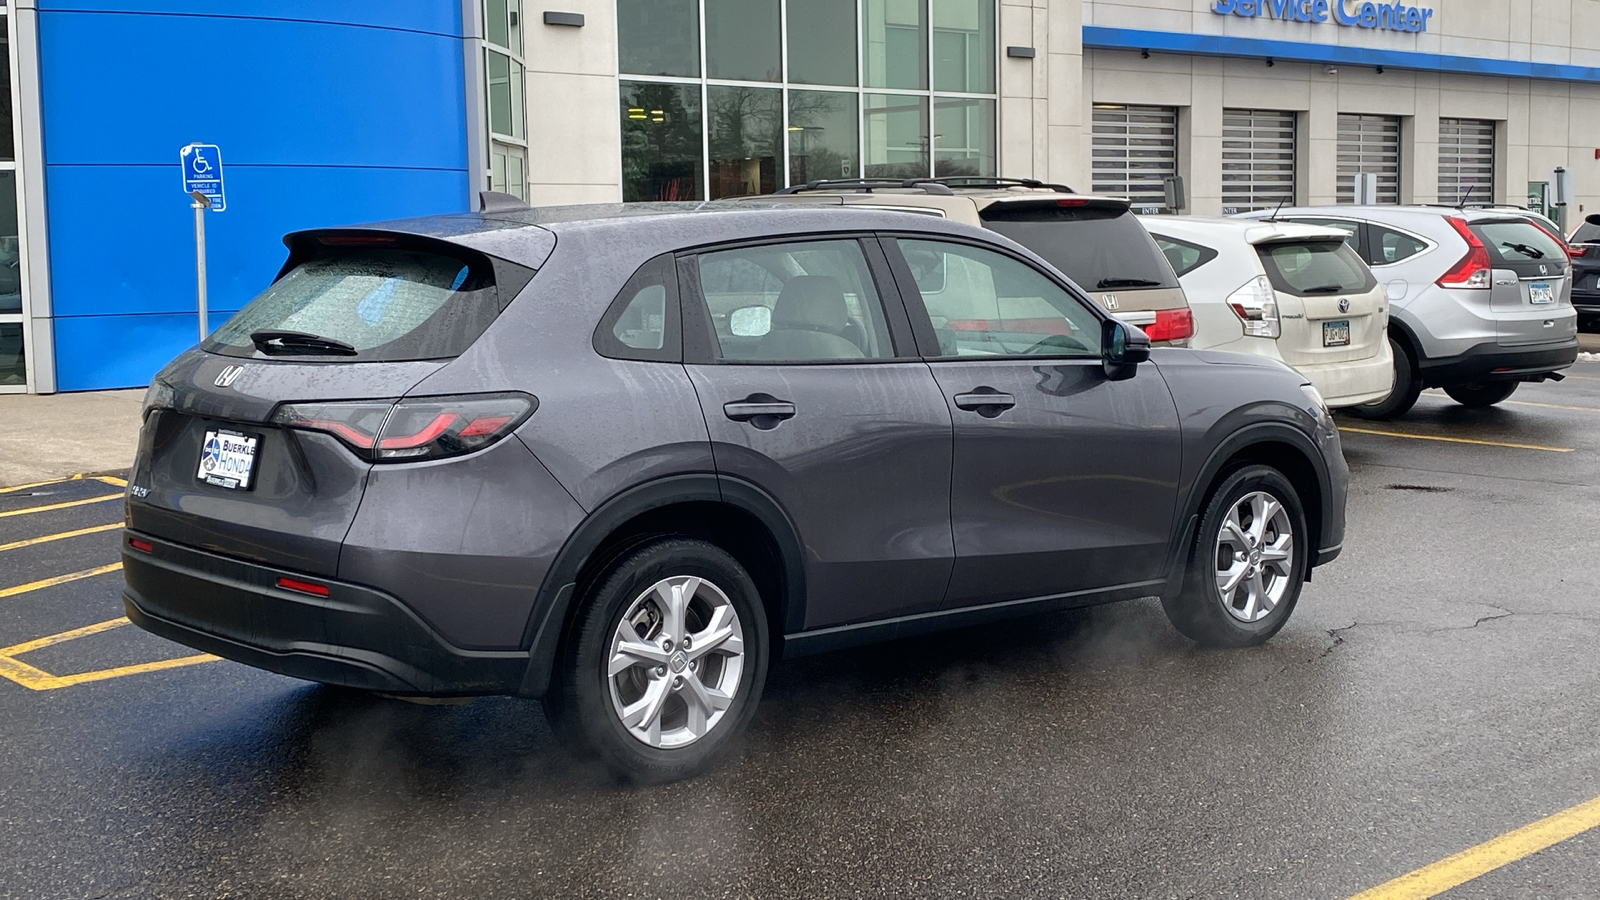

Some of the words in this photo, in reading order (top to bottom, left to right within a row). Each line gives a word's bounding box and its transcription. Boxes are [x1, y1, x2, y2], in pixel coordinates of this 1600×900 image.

[1333, 0, 1433, 32] Center
[1142, 207, 1159, 215] ENTER
[223, 440, 256, 455] BUERKLE
[219, 452, 251, 474] HONDA
